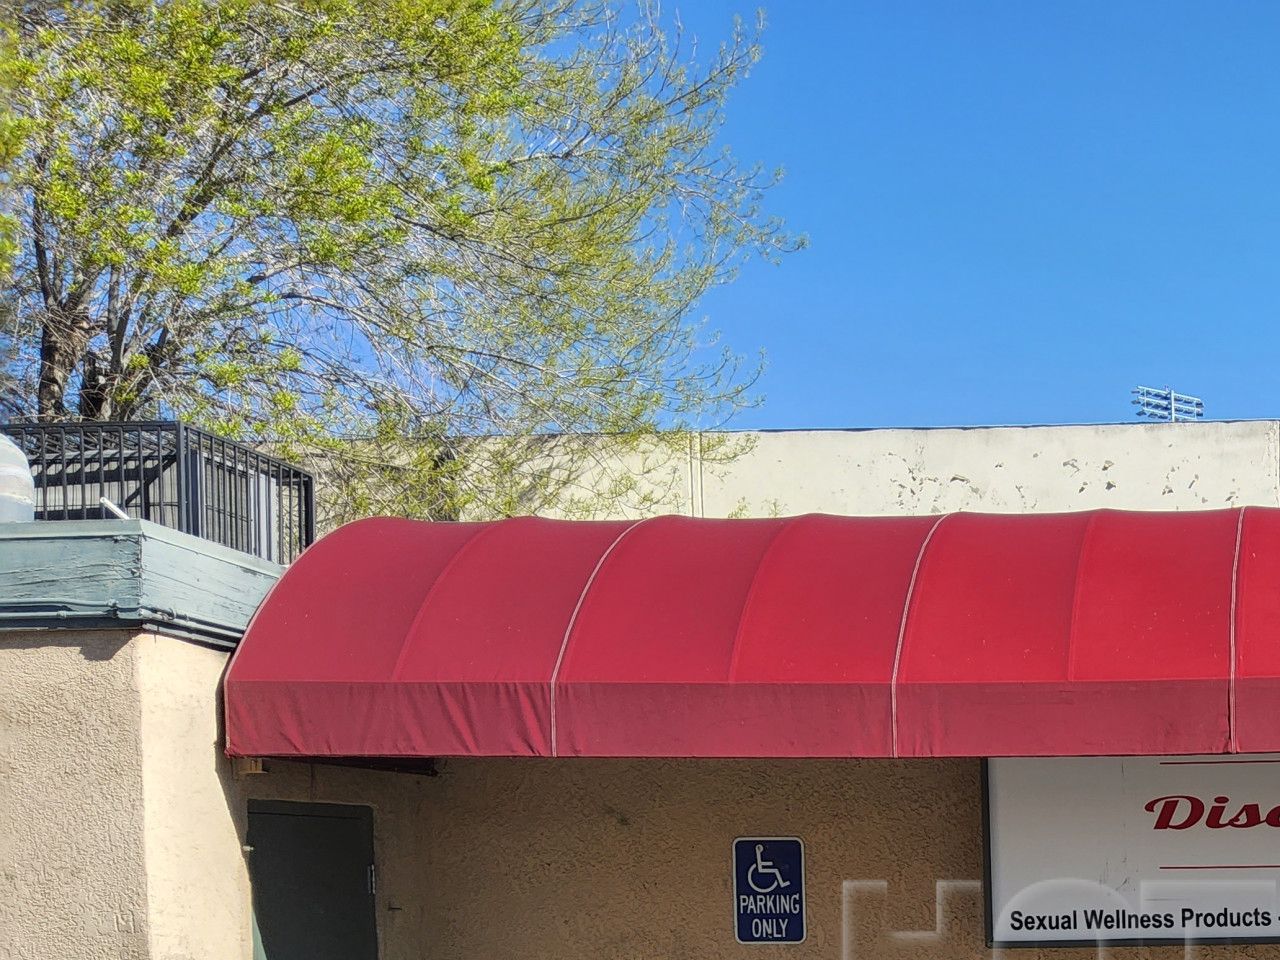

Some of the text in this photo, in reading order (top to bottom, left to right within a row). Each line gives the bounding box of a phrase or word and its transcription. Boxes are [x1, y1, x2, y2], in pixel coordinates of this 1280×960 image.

[740, 893, 800, 915] PARKING
[752, 918, 788, 938] ONLY
[1010, 909, 1078, 931] Sexual
[1083, 908, 1175, 930] Wellness
[1181, 907, 1272, 928] Products
